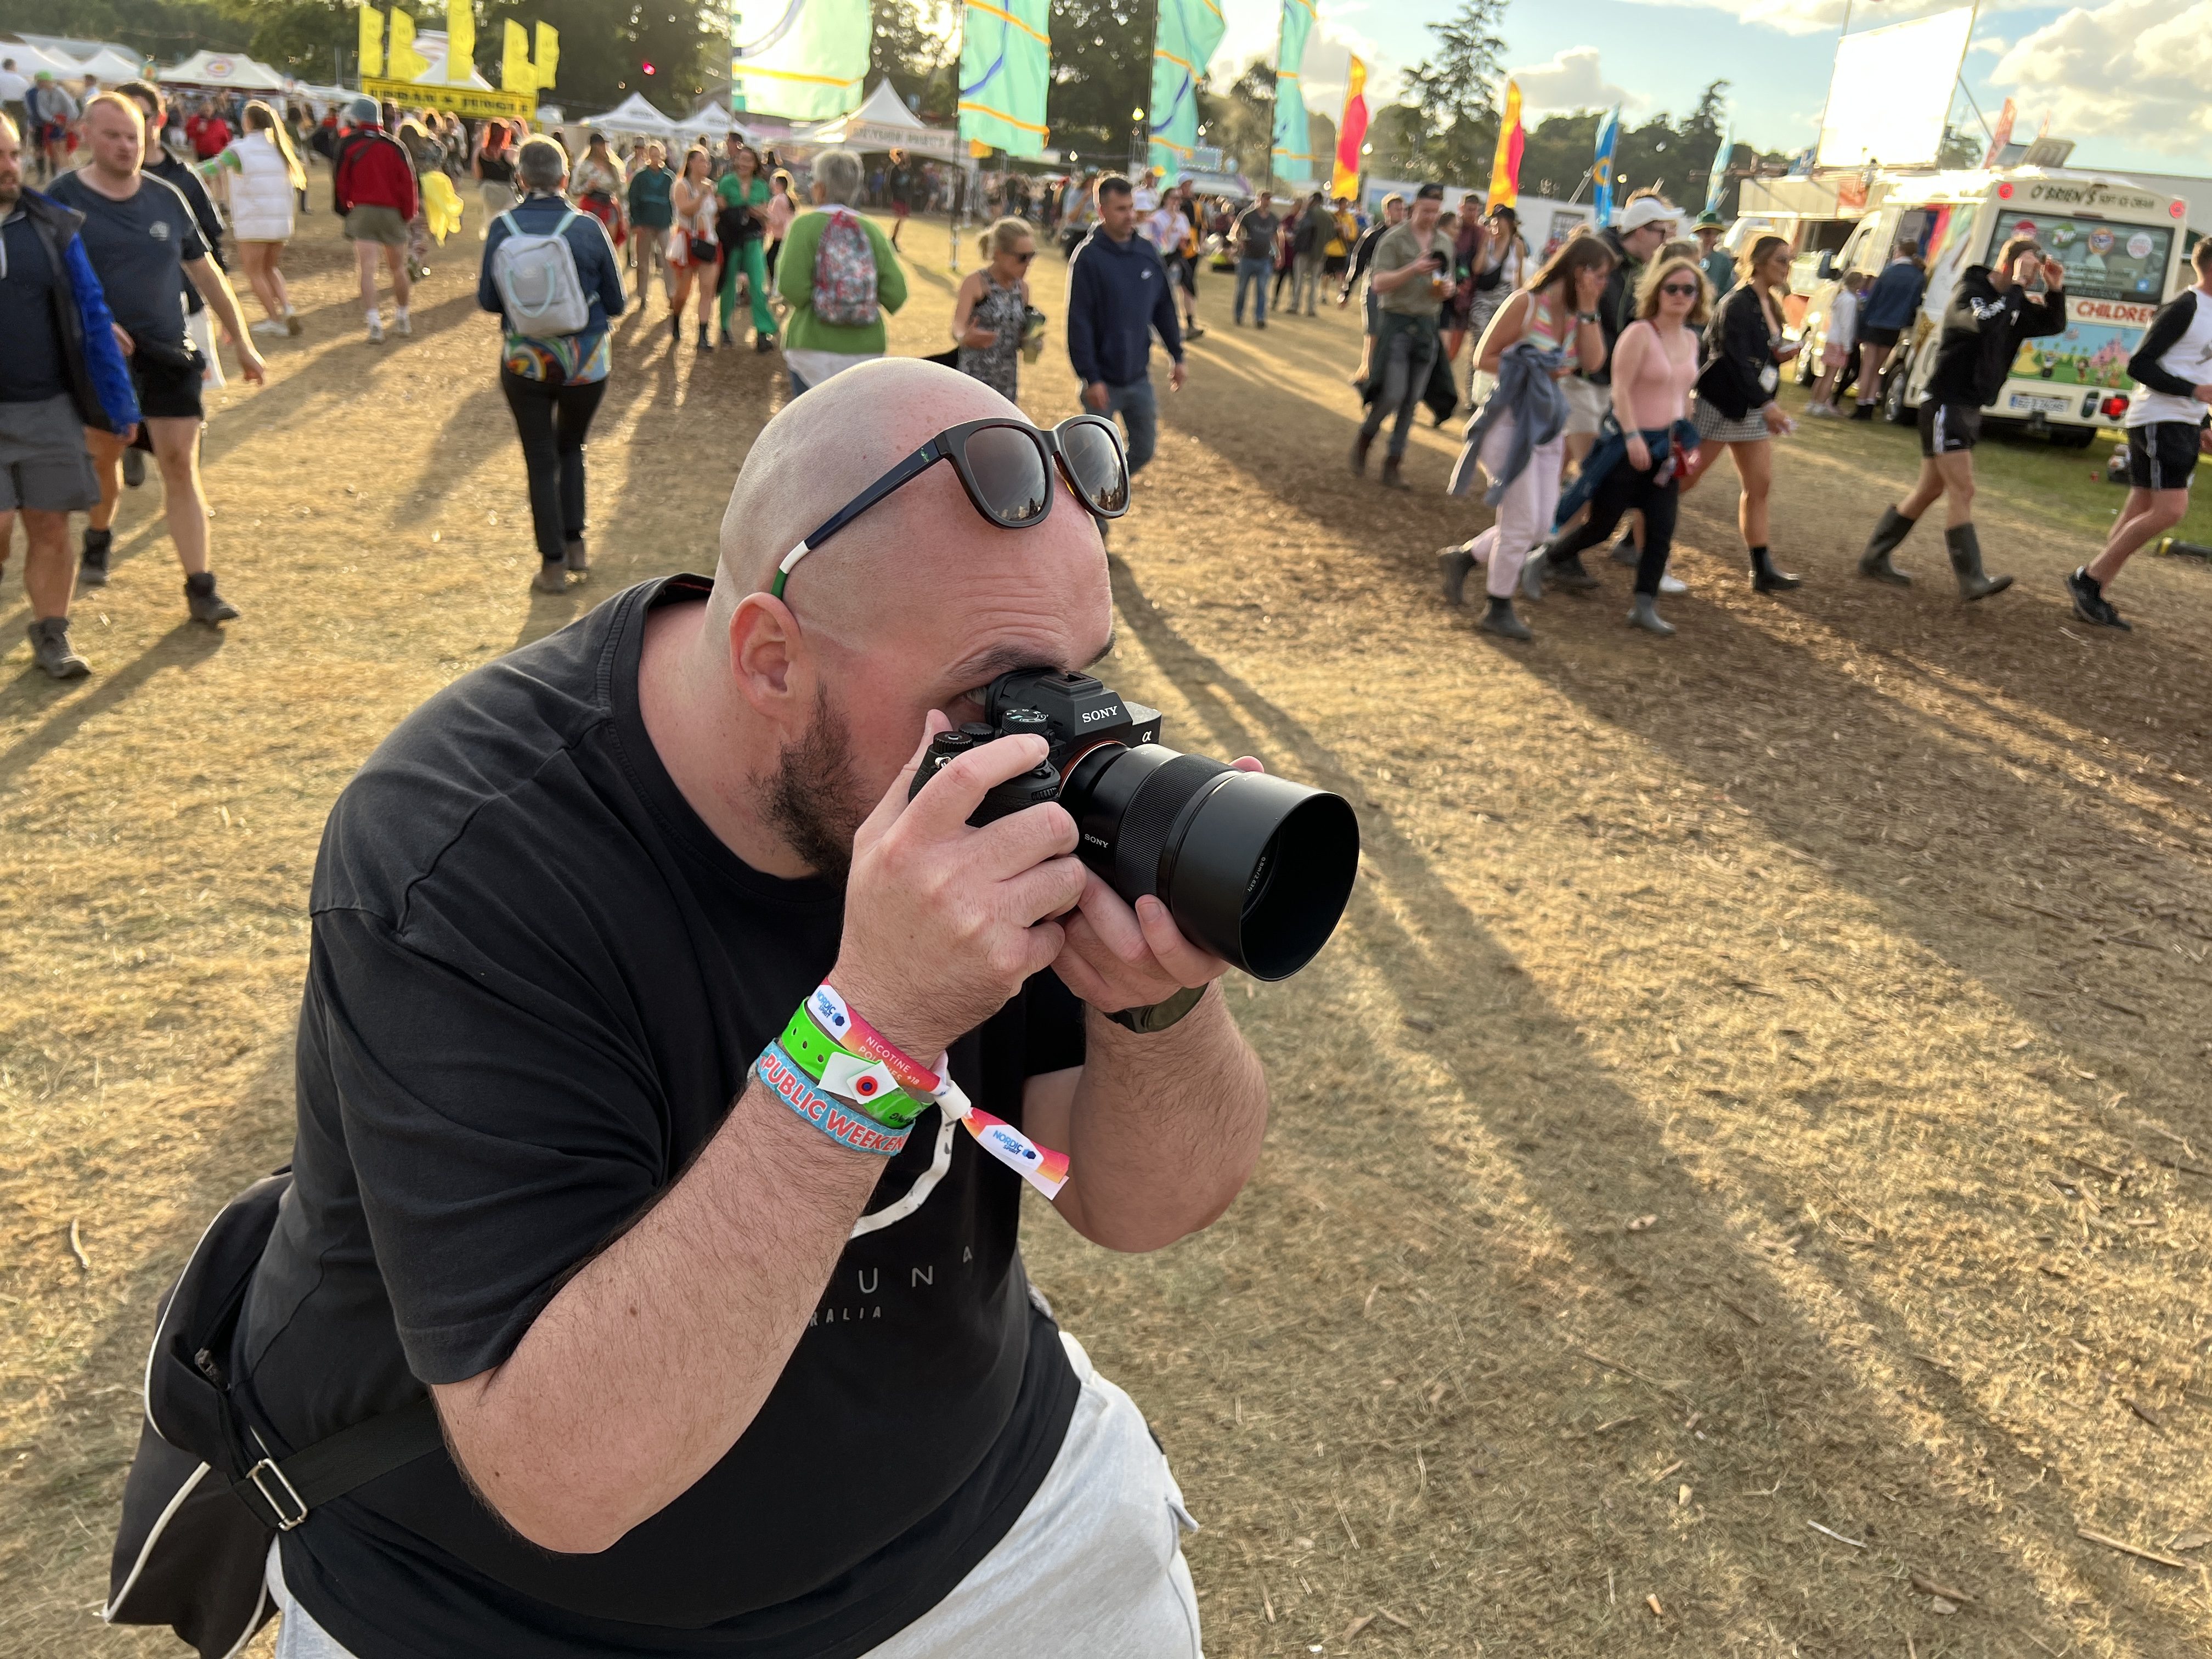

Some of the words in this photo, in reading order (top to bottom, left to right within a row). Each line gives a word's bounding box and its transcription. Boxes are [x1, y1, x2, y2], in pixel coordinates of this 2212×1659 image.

[1082, 706, 1118, 723] SONY
[1085, 833, 1109, 848] SONY
[816, 990, 836, 1014] NORDIC
[818, 1005, 831, 1018] SPIRIT
[858, 1046, 902, 1081] POES
[865, 1036, 911, 1073] NICOTINE
[763, 1053, 827, 1121] PUBLIC
[907, 1075, 920, 1086] +18
[992, 1130, 1023, 1151] NORDIC
[1003, 1144, 1021, 1155] SPIRIT
